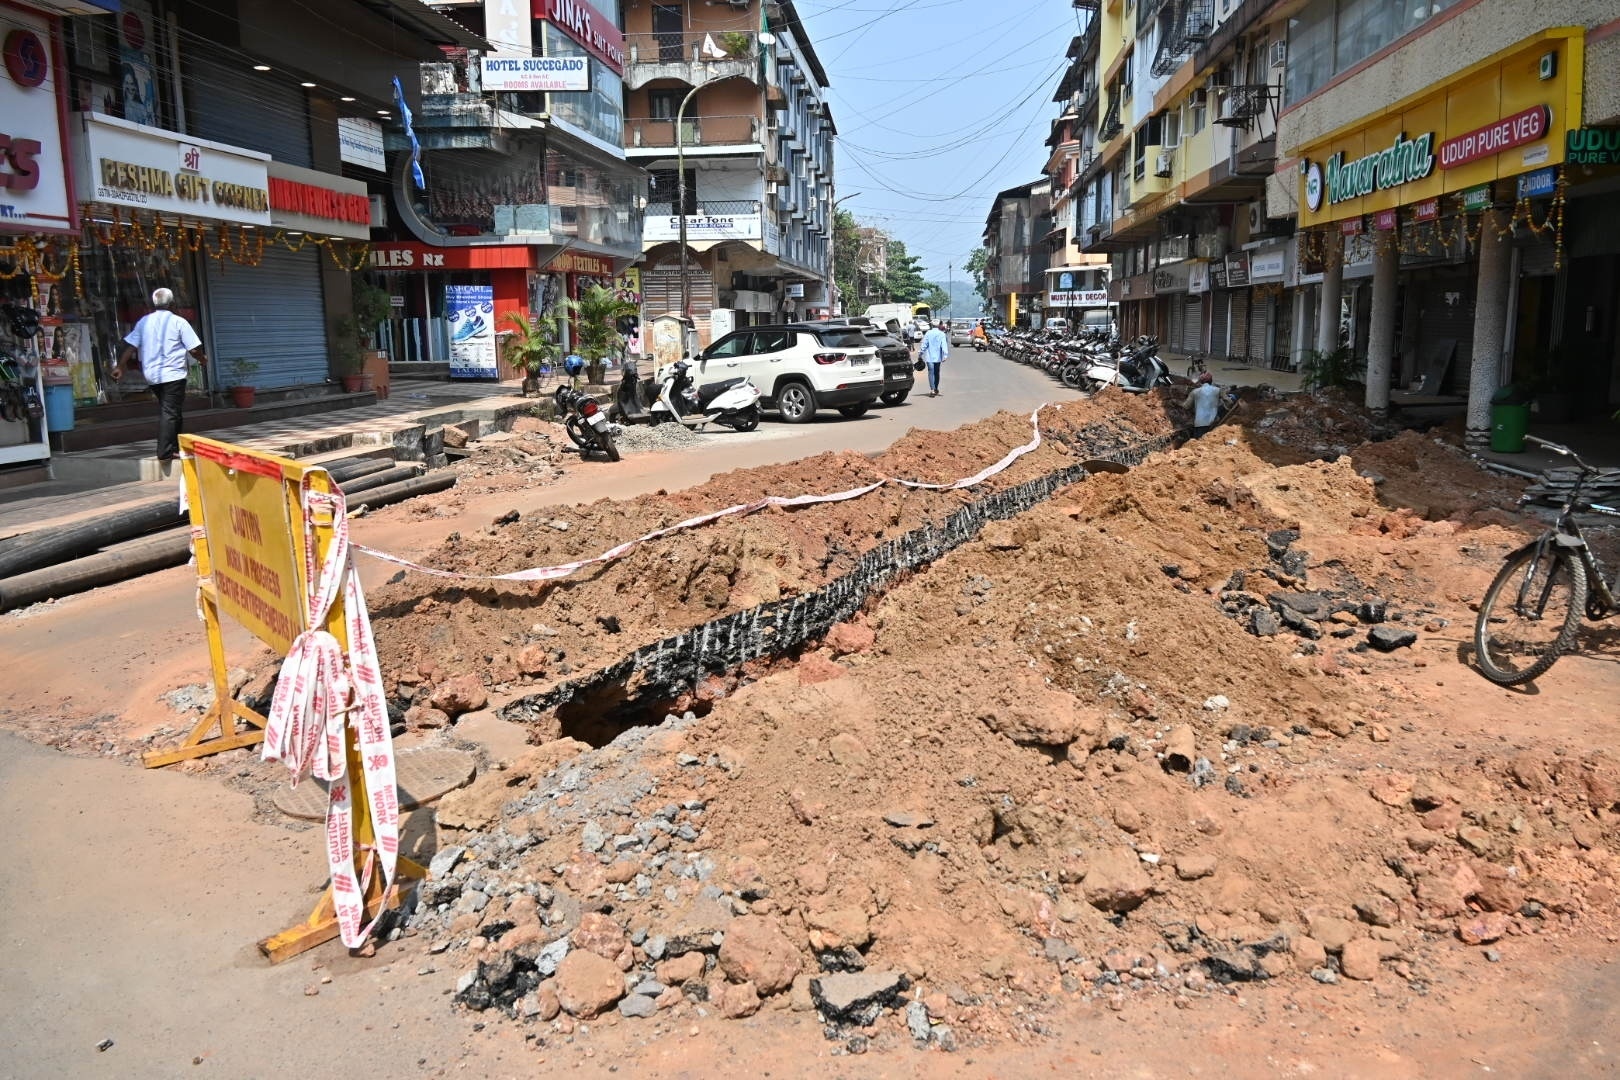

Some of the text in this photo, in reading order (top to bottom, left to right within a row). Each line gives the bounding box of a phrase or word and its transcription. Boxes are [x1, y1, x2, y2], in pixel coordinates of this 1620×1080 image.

[551, 0, 591, 42] JINA'S
[486, 60, 583, 71] HOTEL SUCCEGADO
[504, 81, 566, 89] ROOMS AVAILABLE
[1441, 112, 1540, 164] UDUPI PURE VEG
[184, 148, 200, 169] श्री
[1325, 132, 1433, 205] Navaratna
[1569, 152, 1606, 164] PURE
[99, 158, 175, 197] RESHMA
[175, 173, 211, 202] GIFT
[213, 181, 268, 212] CORNER
[1463, 190, 1487, 205] CHINESE
[423, 253, 445, 267] NX
[573, 255, 600, 273] TEXTILES
[1085, 292, 1107, 300] DECOR
[229, 503, 263, 546] CAUTION
[225, 544, 242, 574] WORK
[373, 790, 388, 826] WORK
[383, 784, 397, 811] MEN
[327, 813, 341, 864] CAUTION
[337, 903, 349, 917] AT
